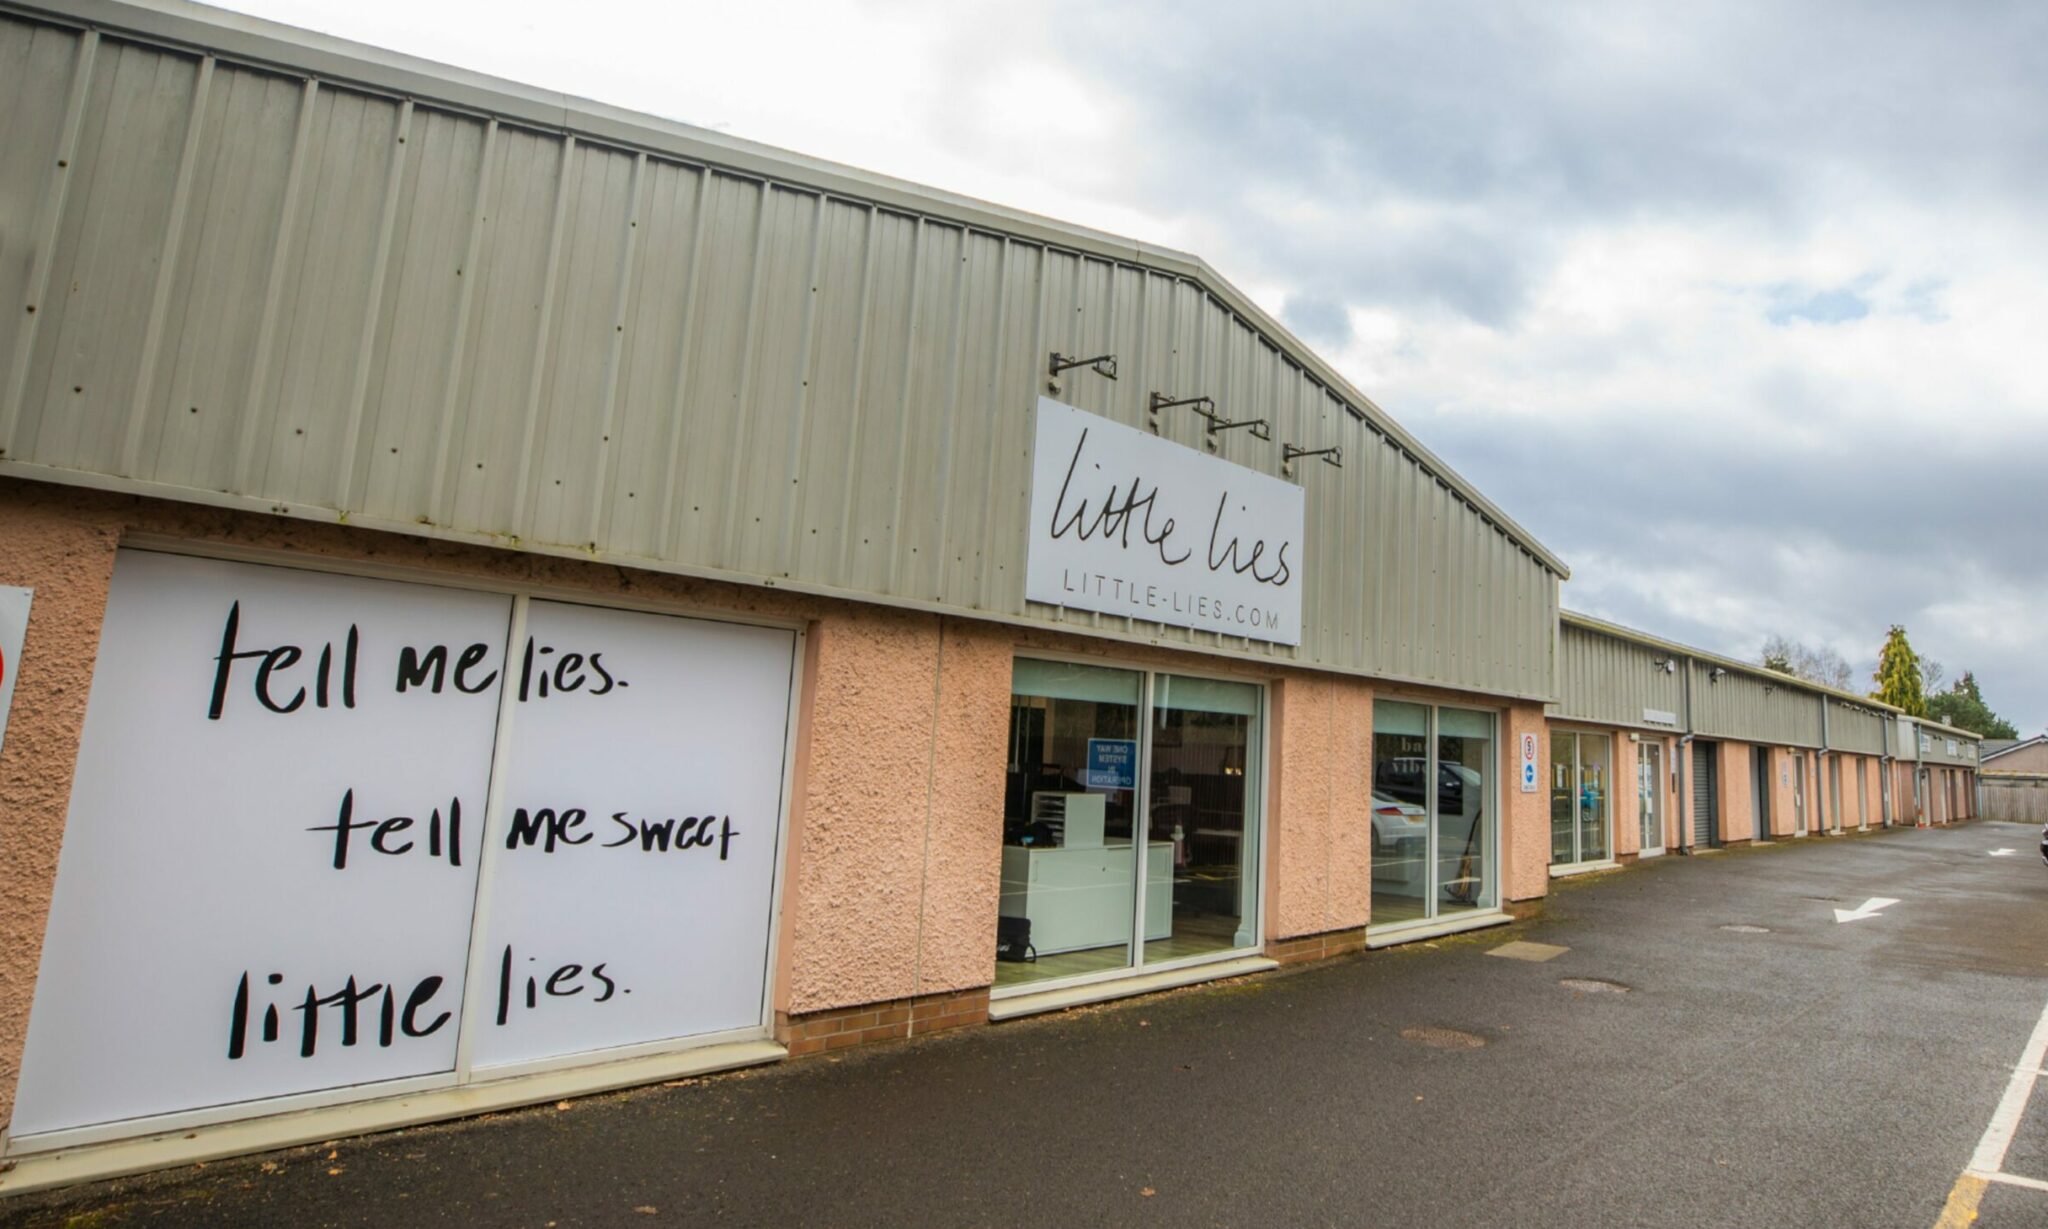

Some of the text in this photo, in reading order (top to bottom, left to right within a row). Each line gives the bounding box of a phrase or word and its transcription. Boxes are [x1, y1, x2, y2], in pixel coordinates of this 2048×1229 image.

[1051, 427, 1290, 586] little lies
[1063, 568, 1279, 629] LITTLE-LIES.COM
[207, 599, 359, 721] tell
[518, 635, 630, 703] lies.
[306, 788, 462, 871] tell
[601, 812, 741, 861] sweet
[227, 943, 632, 1060] little lies.
